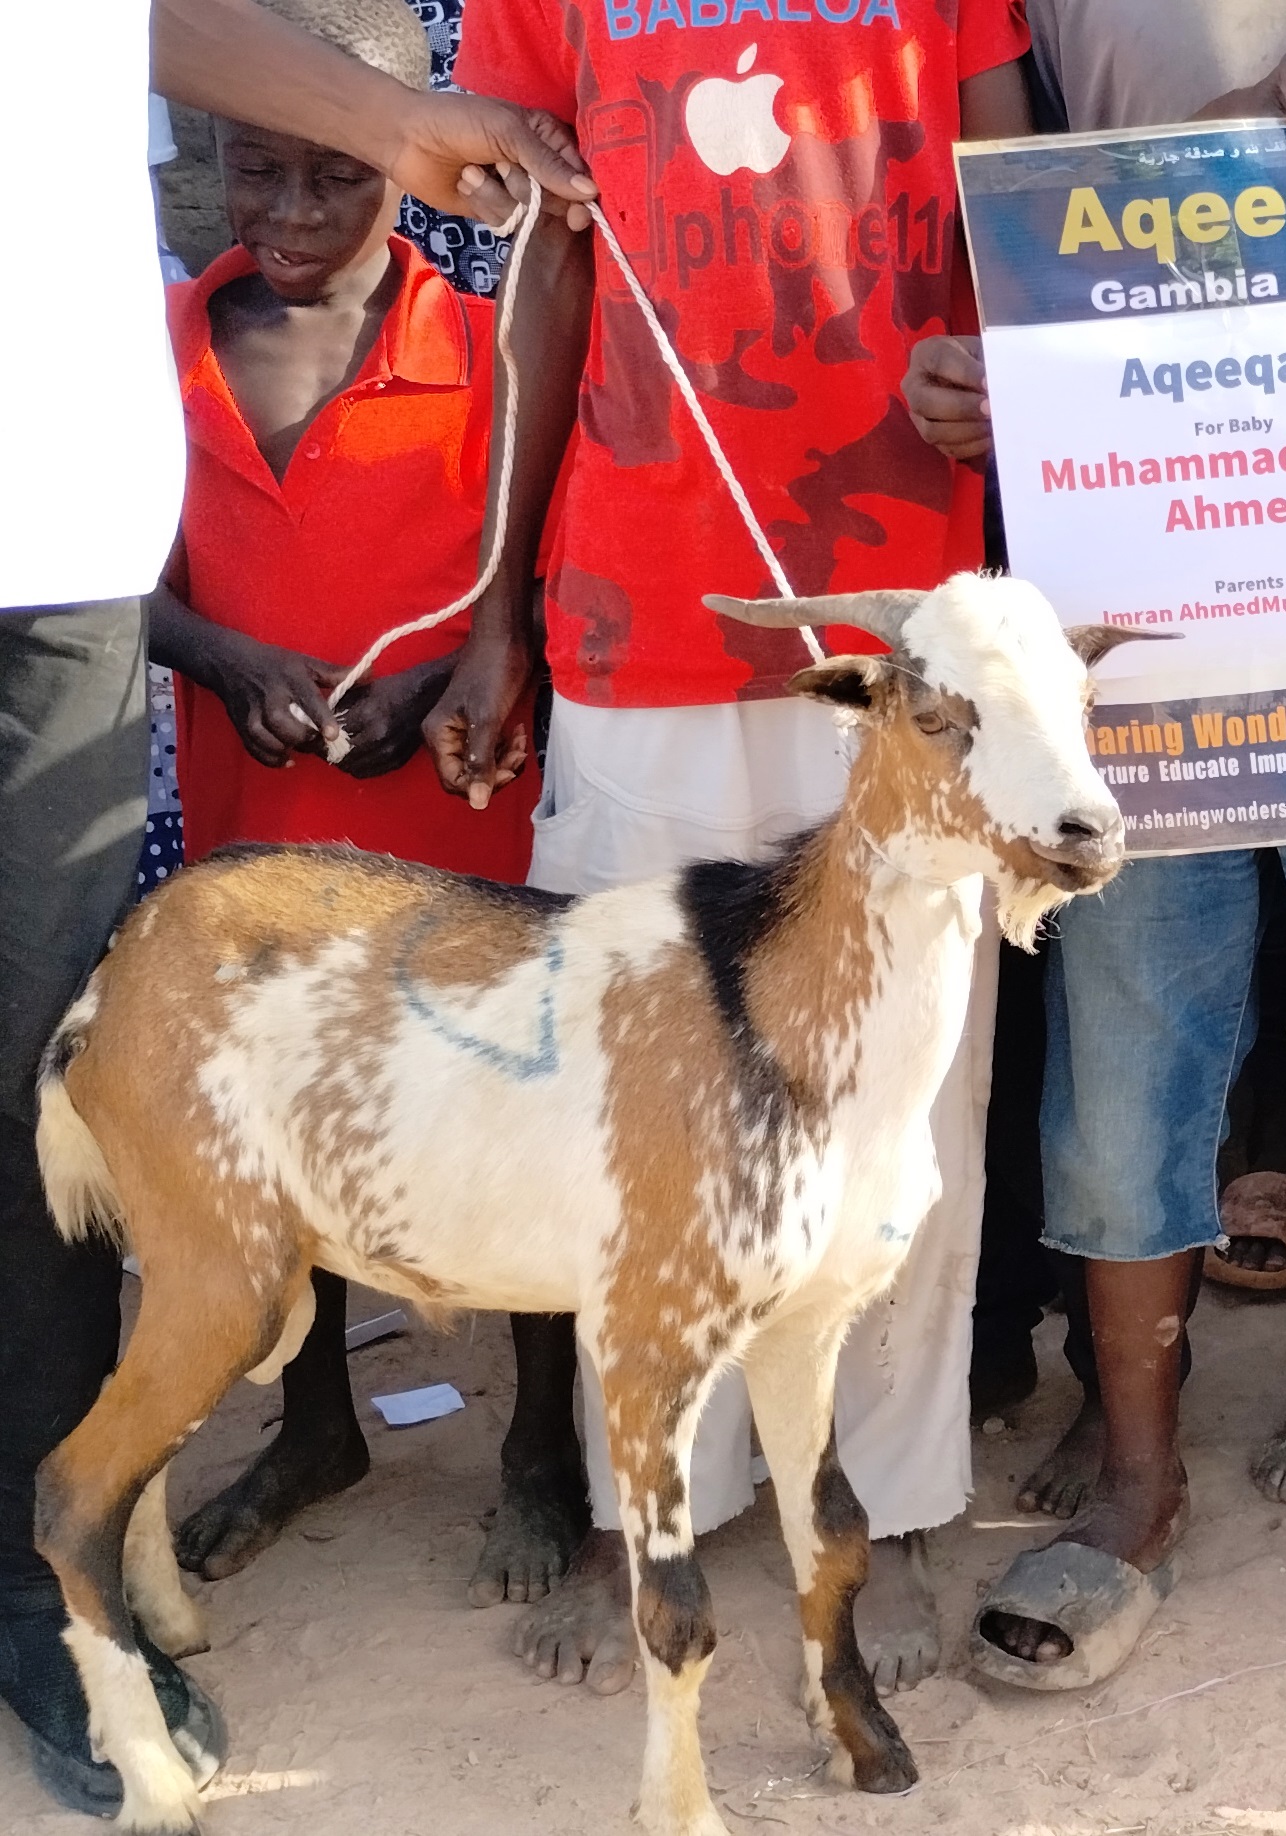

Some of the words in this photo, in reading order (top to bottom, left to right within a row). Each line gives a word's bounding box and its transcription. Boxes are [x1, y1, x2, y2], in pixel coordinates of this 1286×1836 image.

[1090, 268, 1279, 313] Gambia
[1194, 419, 1224, 437] For
[1229, 415, 1274, 436] Baby
[1214, 576, 1284, 594] Parents
[1103, 606, 1173, 626] Imran
[1085, 720, 1184, 756] aring
[1098, 764, 1150, 785] rture
[1159, 757, 1240, 782] Educate
